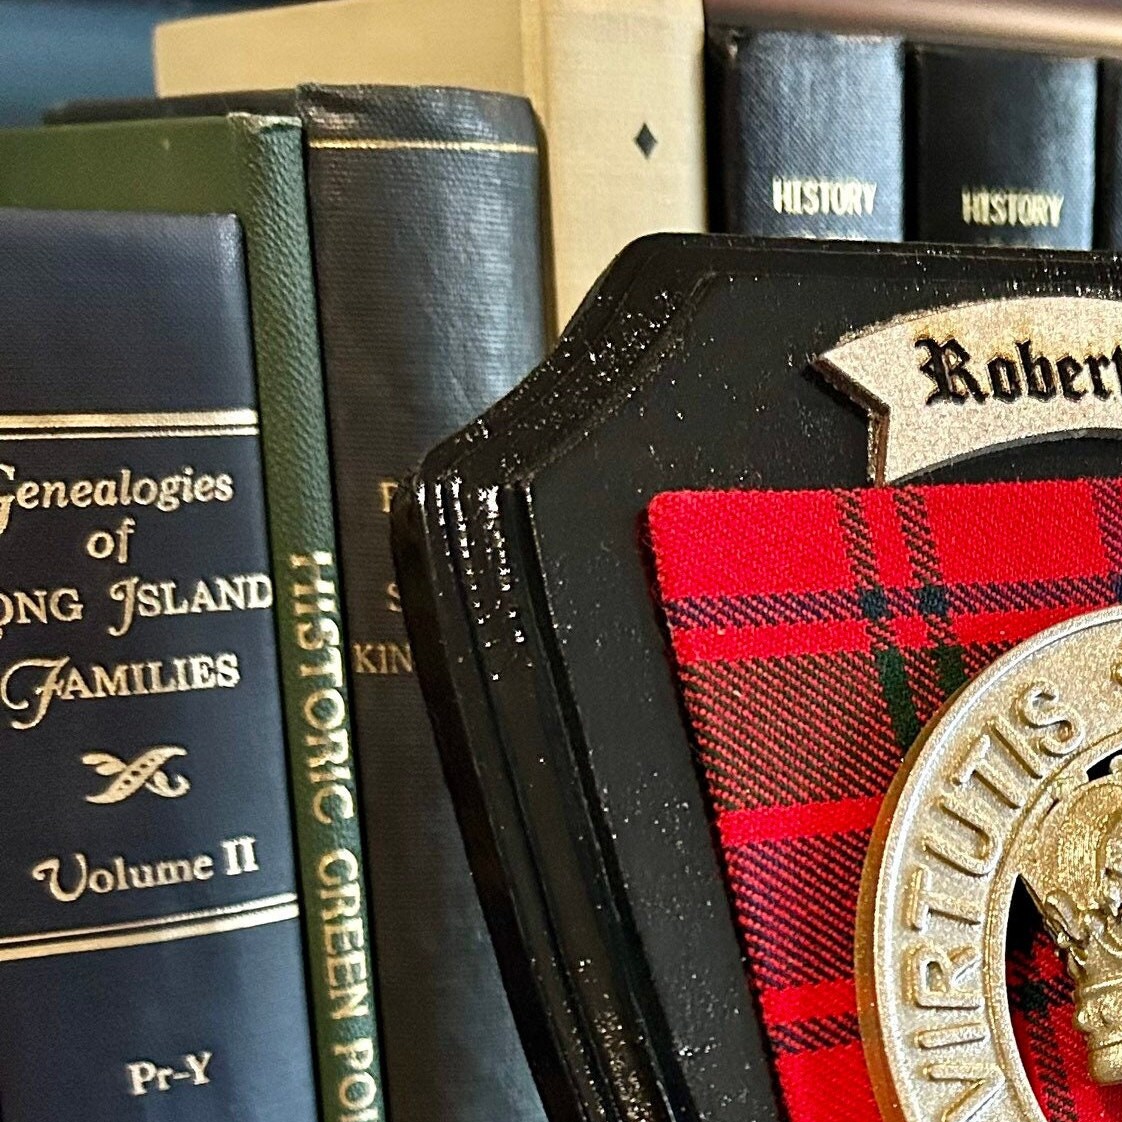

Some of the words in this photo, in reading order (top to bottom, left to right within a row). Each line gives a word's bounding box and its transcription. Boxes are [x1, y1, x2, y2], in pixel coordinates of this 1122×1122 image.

[772, 175, 878, 215] HISTORY
[961, 186, 1065, 227] HISTORY
[86, 517, 136, 563] of
[1, 653, 241, 730] FAMILIES
[289, 550, 354, 825] HISTORIC
[33, 853, 214, 901] Volume
[220, 836, 260, 877] II
[318, 848, 369, 1020] GREEN
[125, 1051, 213, 1096] Pr-Y
